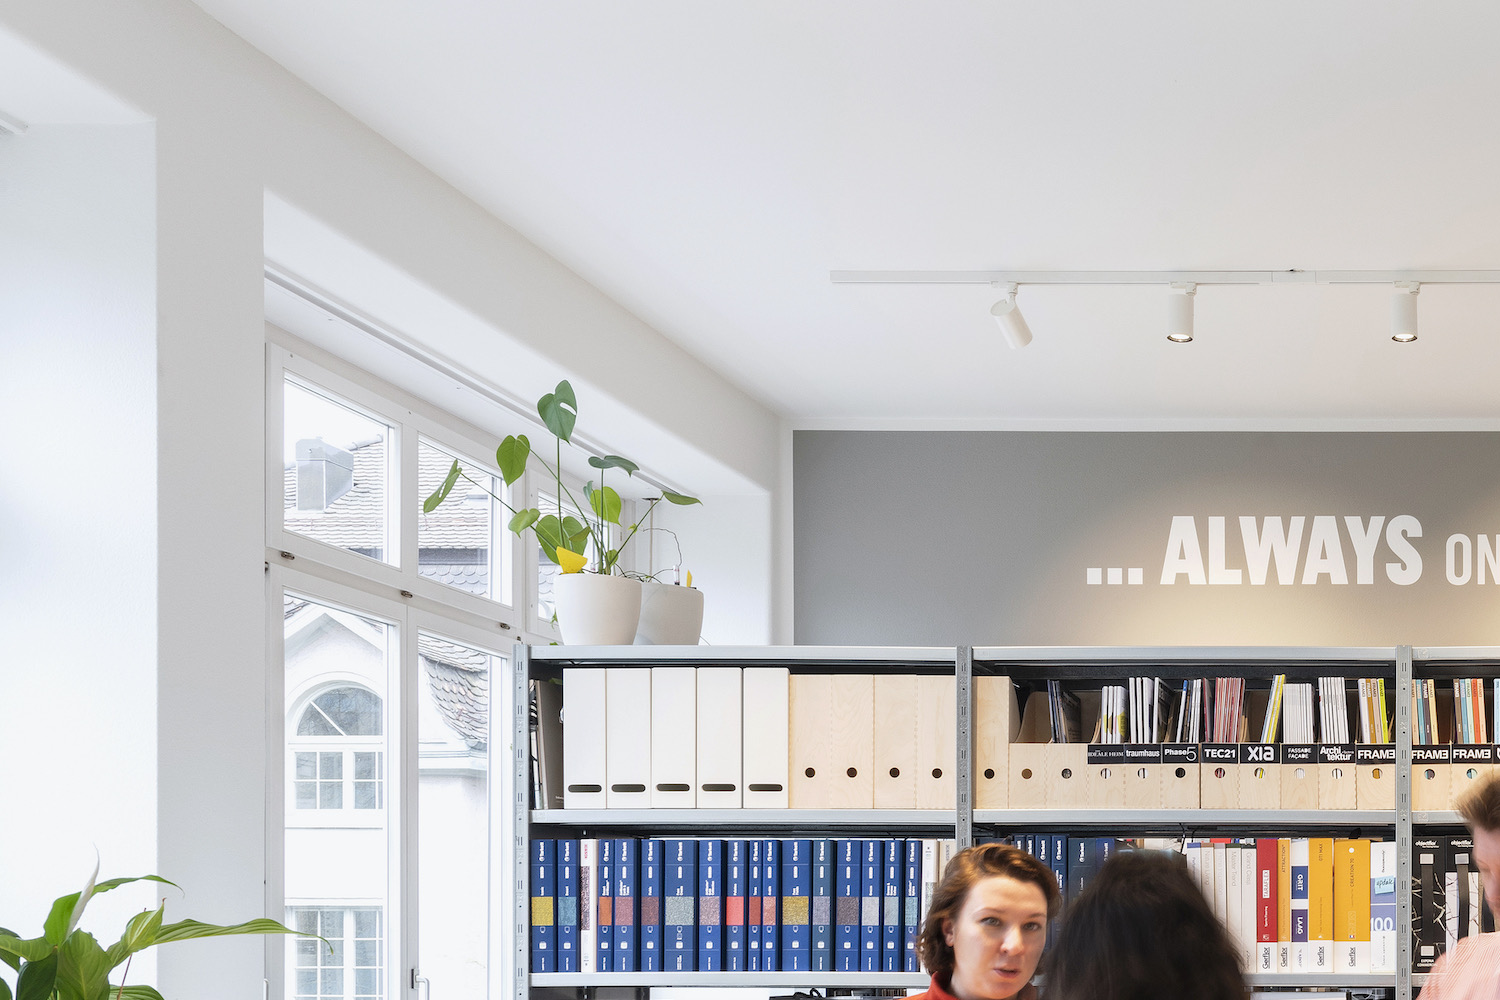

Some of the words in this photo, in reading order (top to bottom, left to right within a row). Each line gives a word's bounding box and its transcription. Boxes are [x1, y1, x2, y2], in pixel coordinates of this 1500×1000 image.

[1160, 513, 1424, 586] ALWAYS
[1126, 749, 1160, 757] traumhaus
[1204, 748, 1236, 759] TEC21
[1320, 746, 1341, 755] Archi
[1357, 749, 1396, 760] FRAME
[1411, 749, 1449, 760] FRAME
[1453, 749, 1491, 760] FRAME
[1370, 916, 1394, 931] 100
[1262, 946, 1270, 969] Gerflor
[1317, 946, 1325, 966] Gerflor
